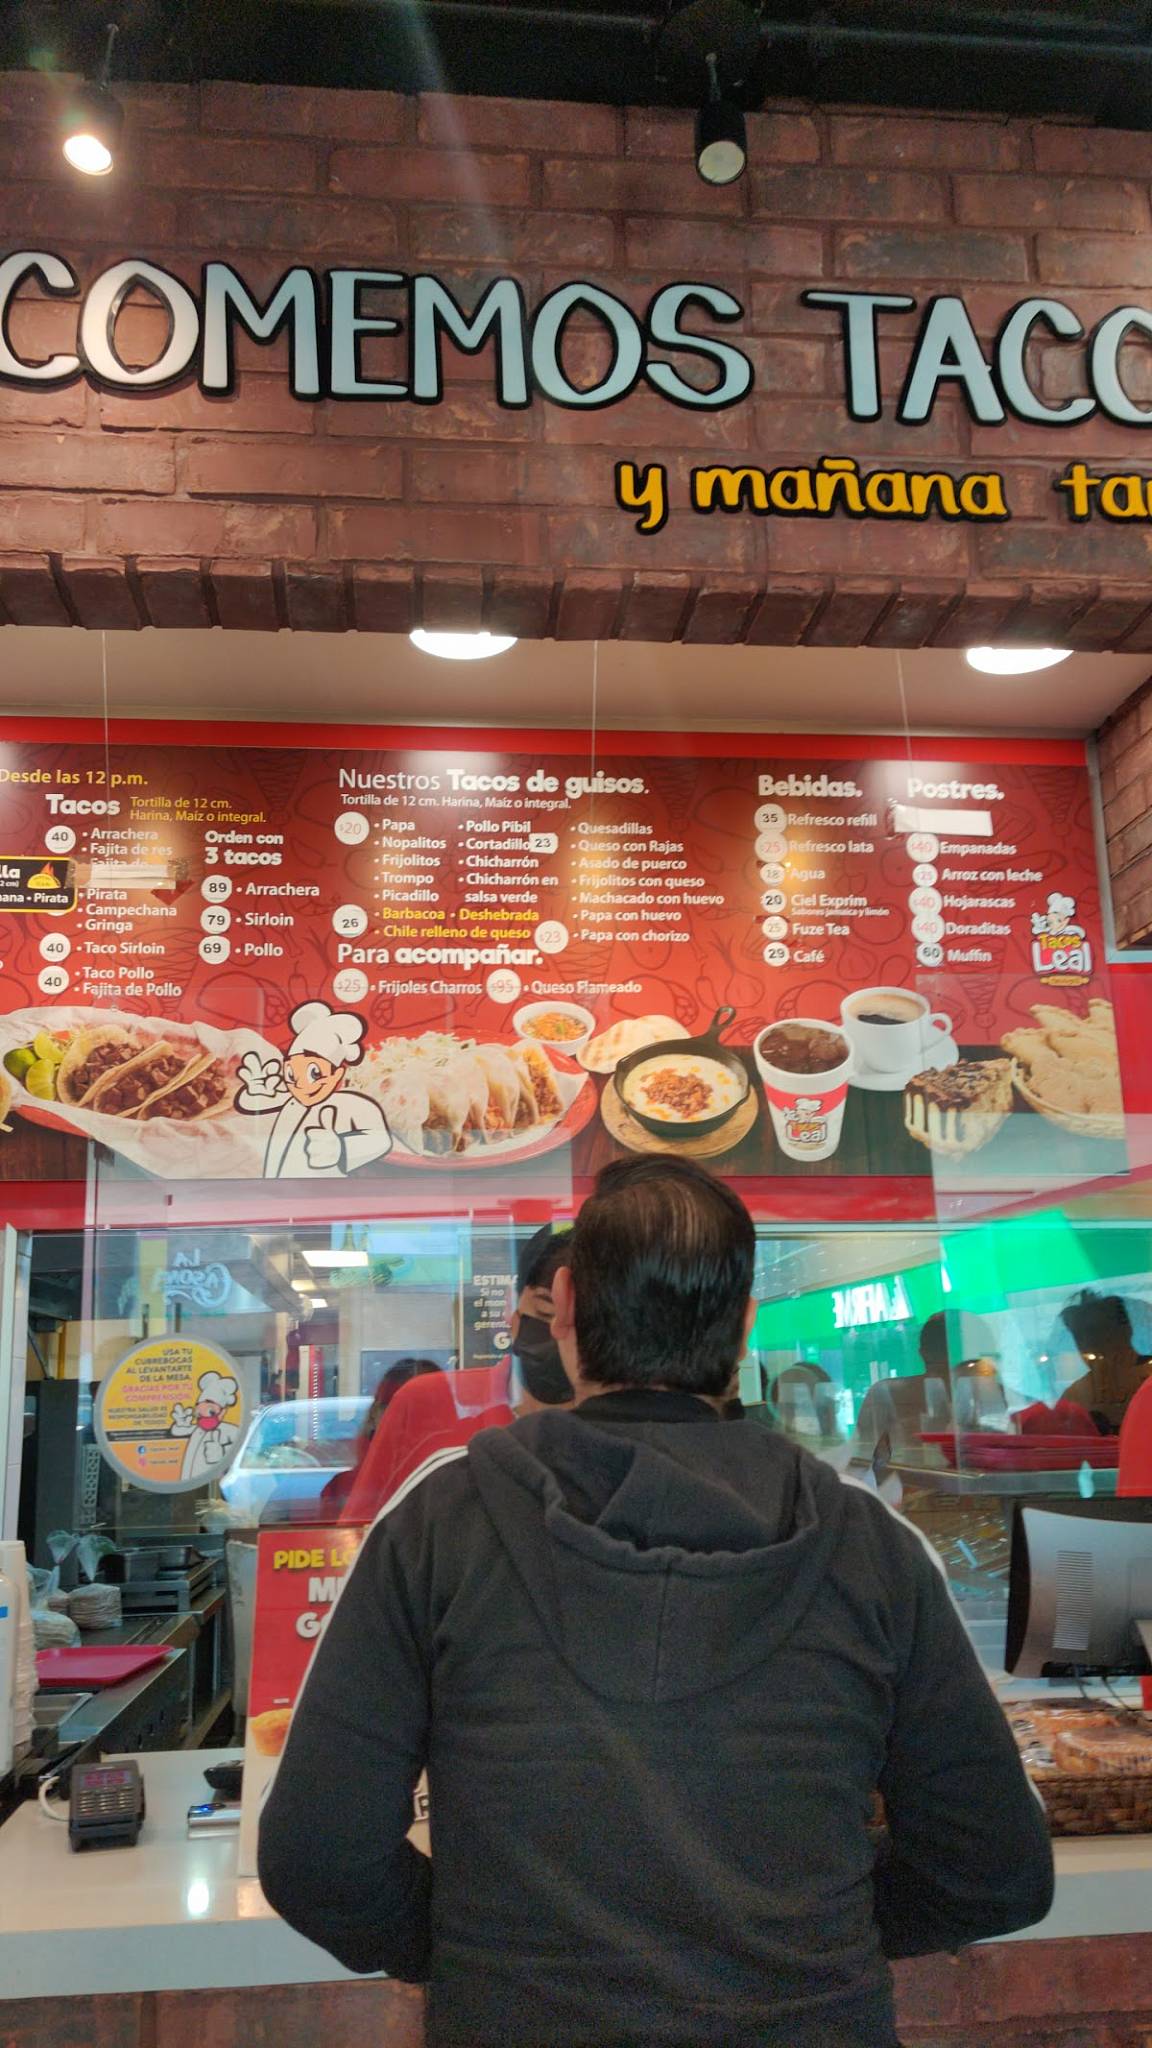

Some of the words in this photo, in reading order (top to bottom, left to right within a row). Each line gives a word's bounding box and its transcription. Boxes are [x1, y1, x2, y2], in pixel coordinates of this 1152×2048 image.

[0, 248, 754, 411] COMEMOS
[614, 458, 668, 535] y
[693, 456, 1010, 523] mañana
[1053, 461, 1152, 523] ta
[0, 769, 51, 783] Desde
[56, 769, 80, 784] las
[86, 771, 106, 785] 12
[111, 773, 148, 788] p.m.
[339, 768, 441, 790] Nuestros
[446, 769, 521, 792] Tacos
[526, 770, 559, 792] de
[565, 771, 649, 799] guisos.
[758, 774, 863, 797] Bebidas.
[907, 778, 1005, 800] Postres.
[45, 793, 121, 815] Tacos
[130, 796, 172, 808] Tortilla
[174, 798, 190, 809] de
[194, 799, 208, 809] 12
[210, 800, 232, 809] cm.
[341, 794, 381, 806] Tortilla
[384, 796, 399, 806] de
[402, 796, 416, 806] 12
[419, 798, 440, 807] cm.
[442, 797, 482, 809] Harina,
[485, 798, 512, 809] Maíz
[514, 801, 523, 809] o
[525, 798, 571, 811] integral.
[130, 810, 173, 823] Harina,
[175, 811, 203, 822] Maíz
[207, 814, 215, 822] o
[217, 811, 266, 824] integral.
[762, 813, 778, 823] 35
[788, 813, 845, 826] Refresco
[382, 818, 415, 832] Papa
[466, 820, 499, 832] Pollo
[502, 821, 531, 833] Pibil
[578, 822, 653, 835] Quesadillas
[51, 832, 69, 841] 40
[90, 828, 159, 840] Arrachera
[204, 830, 253, 844] Orden
[256, 834, 283, 845] con
[90, 842, 128, 857] Fajita
[382, 837, 446, 850] Nopalitos
[535, 838, 552, 848] 23
[578, 839, 621, 853] Queso
[622, 843, 647, 852] con
[649, 840, 684, 854] Rajas
[788, 840, 847, 852] Refresco
[848, 840, 874, 853] lata
[940, 841, 1017, 856] Empanadas
[204, 847, 218, 864] 3
[224, 848, 282, 865] tacos
[382, 854, 441, 868] Frijolitos
[466, 855, 539, 868] Chicharrón
[579, 857, 620, 869] Asado
[622, 858, 638, 870] de
[641, 860, 687, 872] puerco
[383, 871, 434, 885] Trompo
[466, 872, 539, 886] Chicharrón
[542, 876, 558, 886] en
[791, 868, 825, 881] Agua
[942, 868, 978, 881] Arroz
[980, 871, 1004, 882] con
[1007, 868, 1043, 882] leche
[209, 883, 227, 893] 89
[245, 882, 320, 896] Arrachera
[579, 875, 636, 889] Frijolitos
[638, 877, 664, 888] con
[666, 878, 705, 889] queso
[33, 892, 69, 903] Pirata
[86, 888, 128, 900] Pirata
[383, 890, 439, 902] Picadillo
[465, 890, 497, 903] salsa
[500, 891, 538, 903] verde
[579, 893, 655, 905] Machacado
[657, 895, 681, 905] con
[683, 893, 725, 905] huevo
[765, 895, 782, 906] 20
[791, 893, 816, 906] Ciel
[943, 895, 1016, 910] Hojarascas
[86, 903, 177, 918] Campechana
[383, 907, 445, 920] Barbacoa
[459, 908, 540, 921] Deshebrada
[581, 911, 612, 923] Papa
[615, 913, 639, 922] con
[641, 911, 682, 922] huevo
[85, 919, 133, 933] Gringa
[207, 915, 225, 925] 79
[244, 912, 294, 926] Sirloin
[343, 918, 359, 928] 26
[383, 925, 417, 937] Chile
[421, 926, 468, 938] relleno
[470, 927, 487, 938] de
[490, 929, 531, 941] queso
[793, 922, 824, 935] Fuze
[826, 923, 850, 935] Tea
[945, 922, 1011, 936] Doraditas
[581, 930, 612, 943] Papa
[615, 932, 640, 942] con
[642, 930, 690, 942] chorizo
[1037, 933, 1081, 949] Tacos
[47, 943, 64, 953] 40
[84, 941, 117, 954] Taco
[120, 942, 165, 955] Sirloin
[203, 943, 221, 953] 69
[244, 943, 283, 957] Pollo
[768, 948, 785, 959] 29
[338, 943, 389, 963] Para
[394, 944, 544, 970] acompañar.
[793, 950, 825, 963] Café
[82, 966, 115, 979] Taco
[119, 967, 154, 980] Pollo
[44, 977, 62, 987] 40
[379, 980, 428, 996] Frijoles
[429, 981, 482, 995] Charros
[531, 980, 574, 994] Queso
[577, 980, 642, 994] Flameado
[83, 982, 121, 998] Fajita
[125, 984, 143, 996] de
[147, 984, 182, 997] Pollo
[273, 1549, 325, 1569] PIDE
